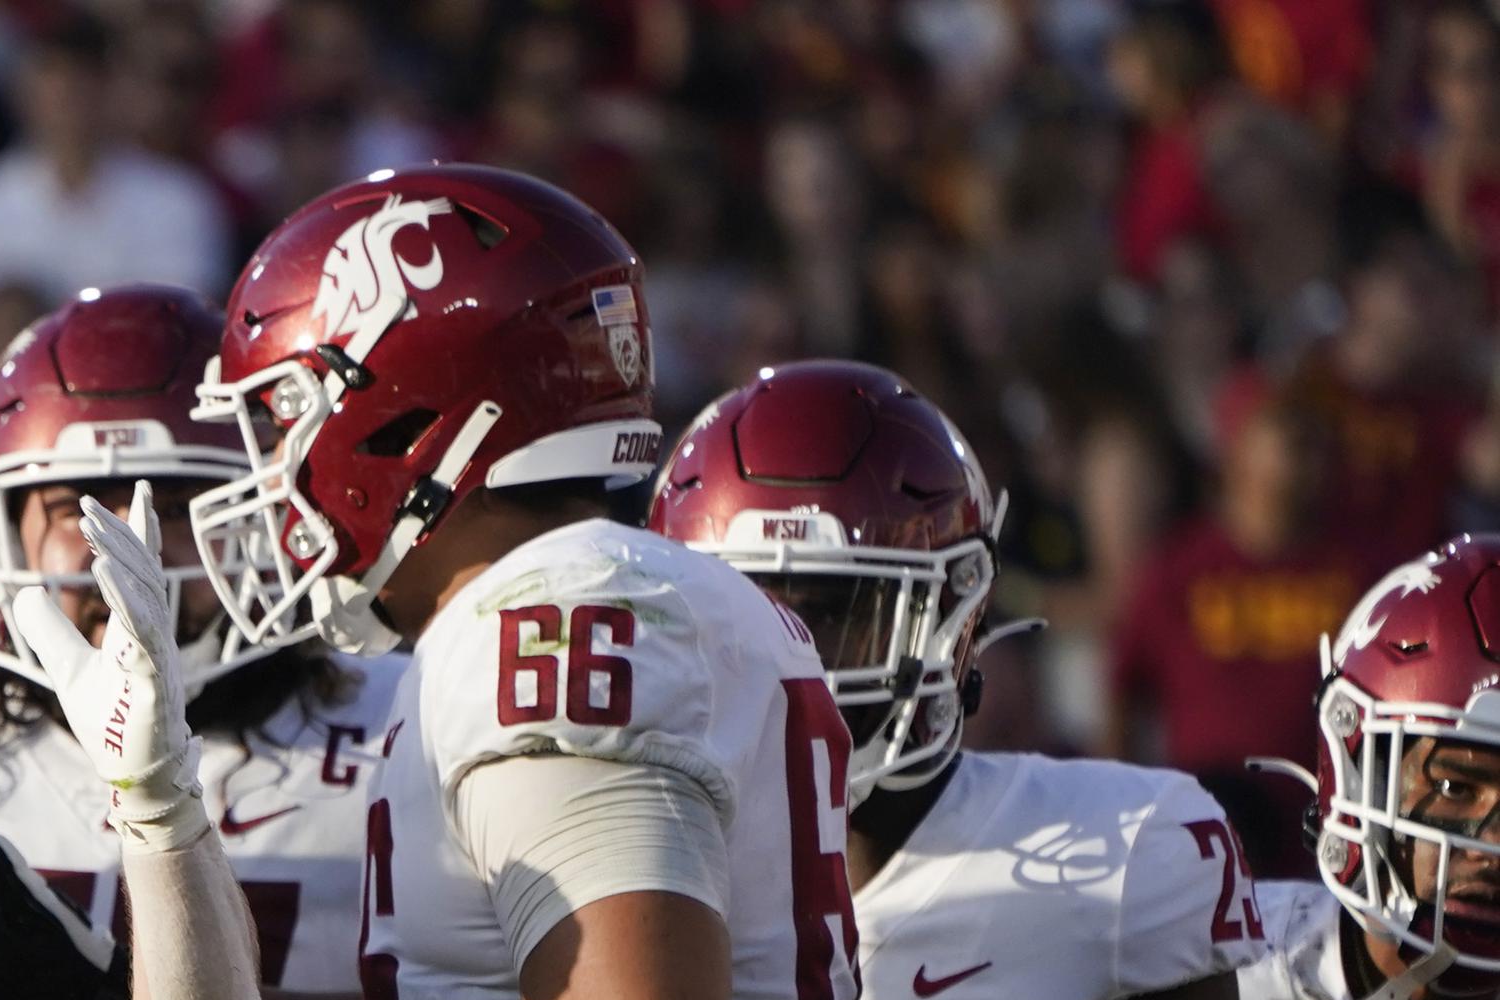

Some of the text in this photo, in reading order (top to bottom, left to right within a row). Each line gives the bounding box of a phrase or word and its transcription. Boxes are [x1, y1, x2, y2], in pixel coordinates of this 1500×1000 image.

[763, 518, 806, 540] WSU
[498, 604, 635, 727] 66
[322, 725, 366, 788] C
